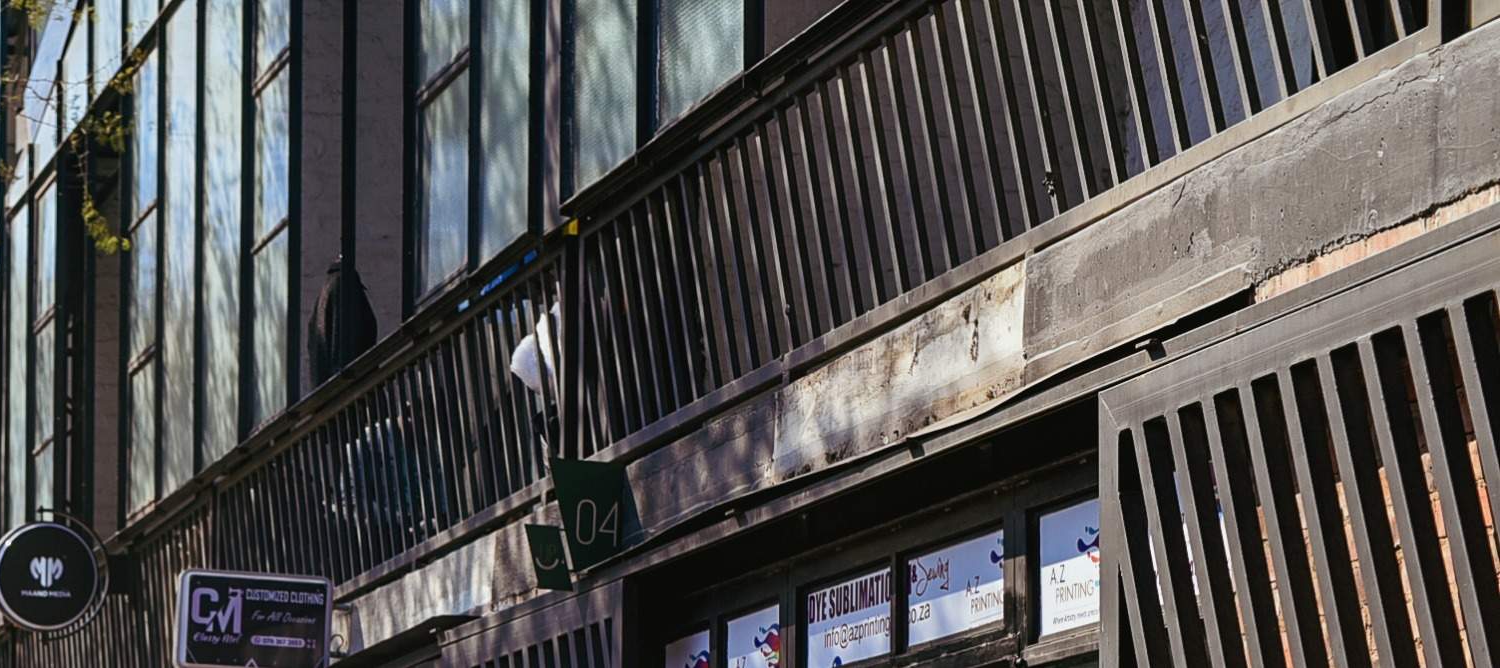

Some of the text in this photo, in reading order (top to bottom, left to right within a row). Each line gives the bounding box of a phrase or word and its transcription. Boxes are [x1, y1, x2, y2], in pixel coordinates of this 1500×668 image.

[575, 499, 619, 547] 04
[246, 588, 324, 605] CUSTOMIZED CLOTHING
[809, 591, 827, 624] DYE
[828, 572, 891, 619] SUBLIMATIO
[1056, 579, 1095, 604] PRINTING
[252, 610, 265, 621] For
[267, 611, 282, 622] All
[908, 603, 931, 624] o.za
